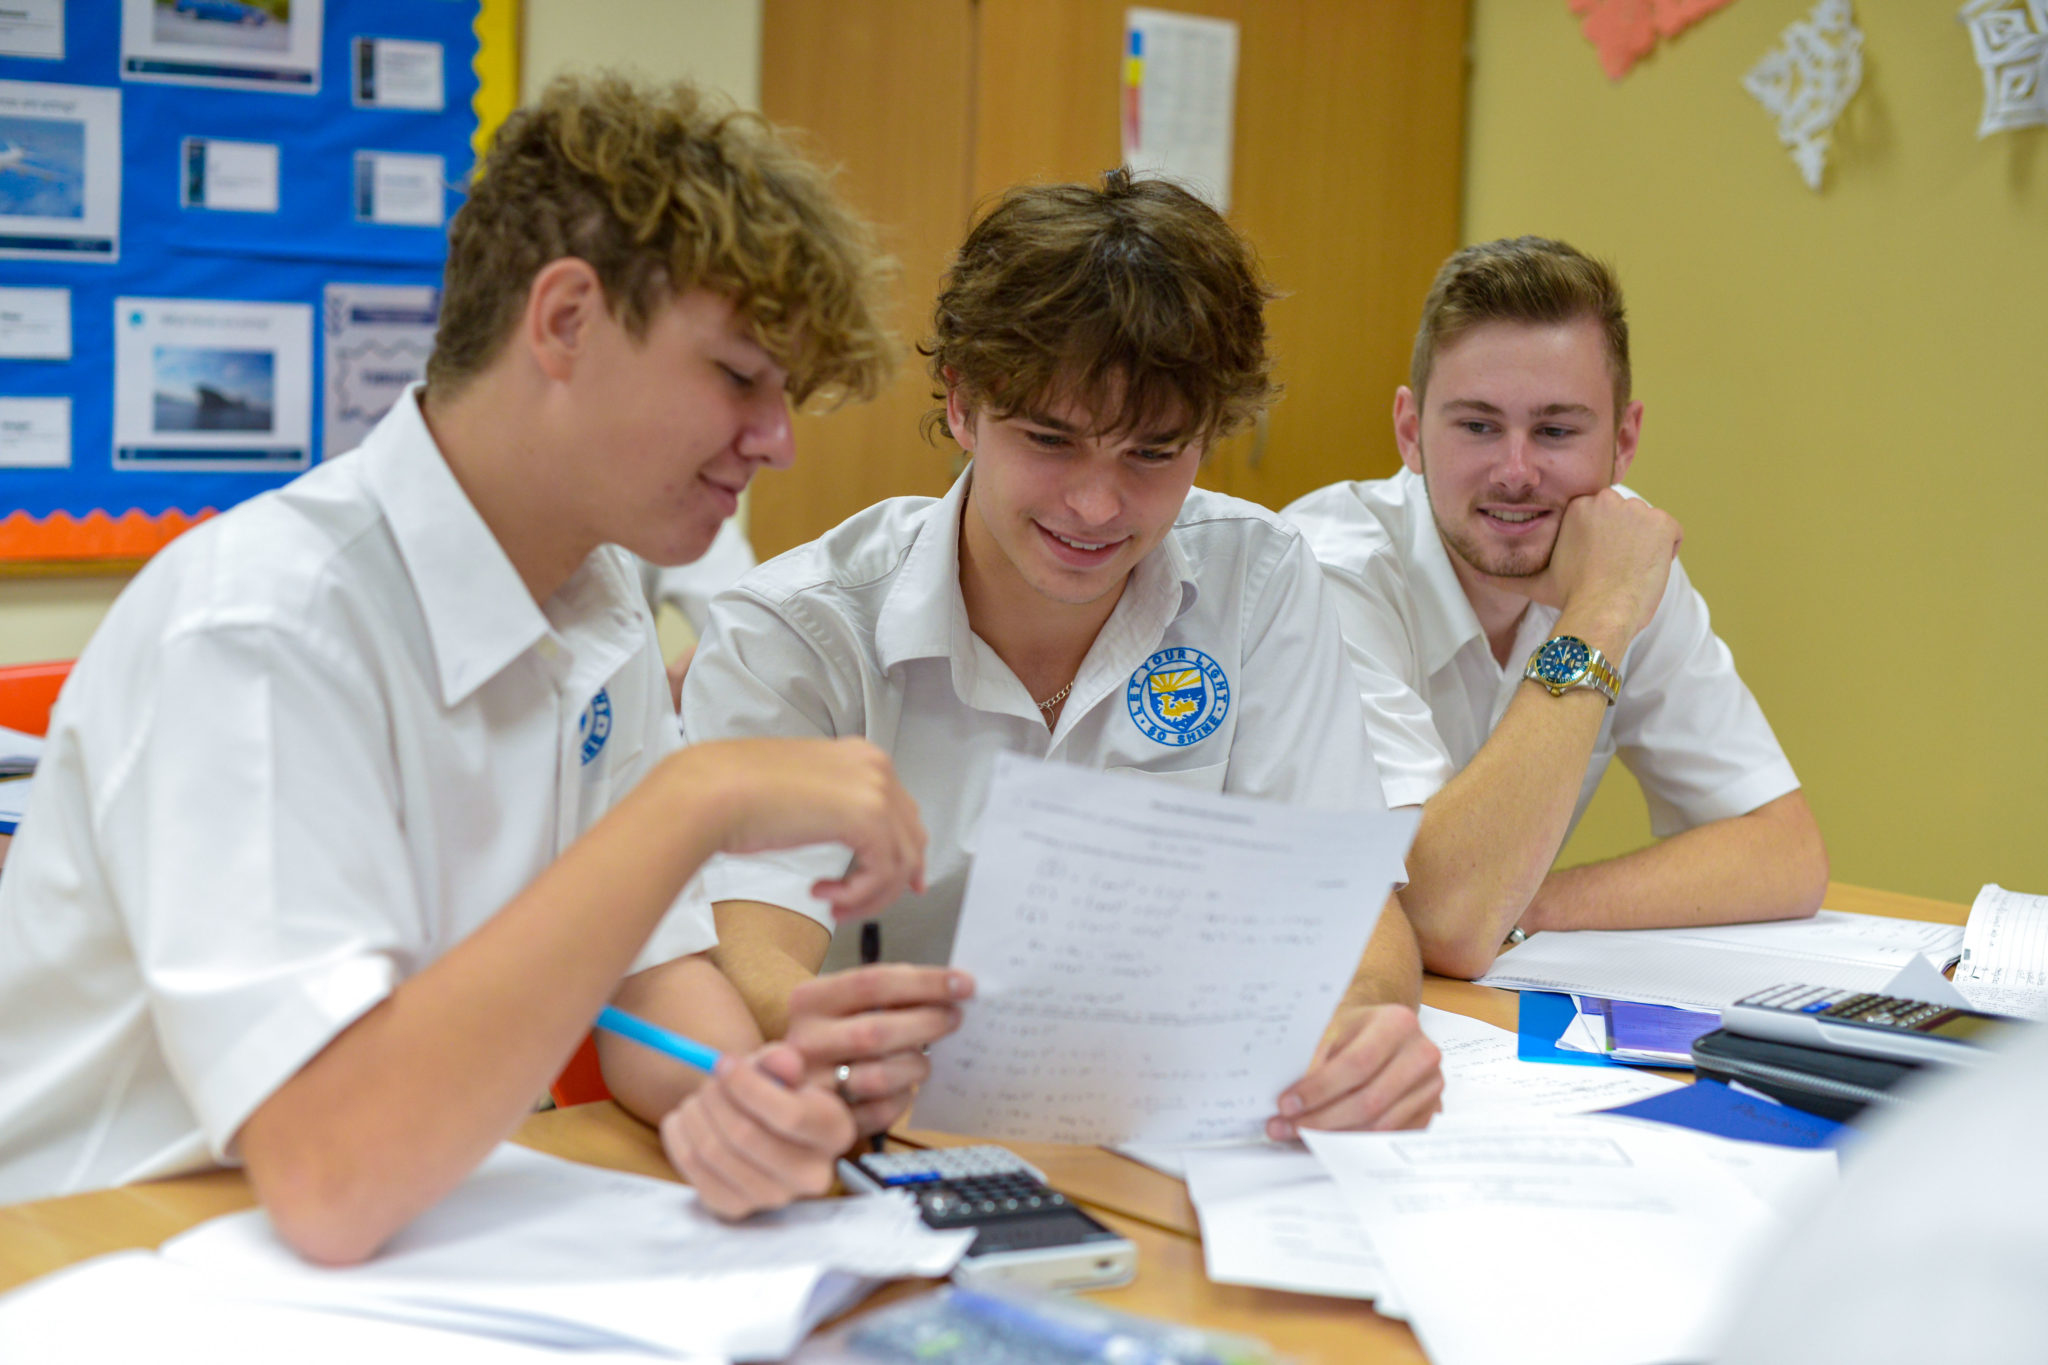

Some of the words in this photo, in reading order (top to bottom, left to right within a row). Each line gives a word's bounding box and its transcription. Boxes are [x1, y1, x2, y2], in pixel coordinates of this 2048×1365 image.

[1129, 679, 1143, 717] LET
[1140, 649, 1186, 672] YOUR
[1196, 654, 1227, 703] LIGHT
[1147, 726, 1167, 741] SO
[1177, 715, 1219, 744] SHINE
